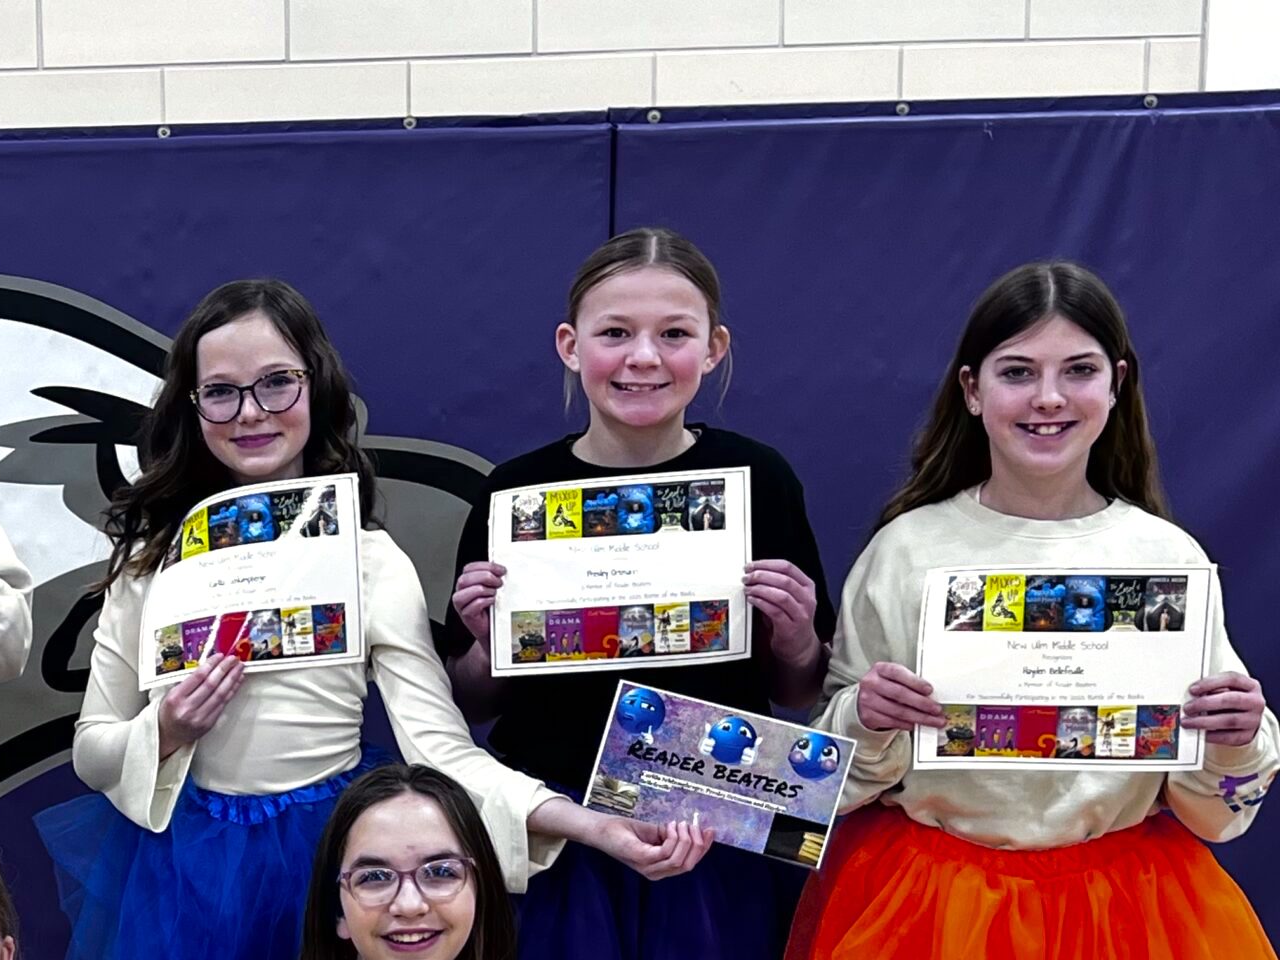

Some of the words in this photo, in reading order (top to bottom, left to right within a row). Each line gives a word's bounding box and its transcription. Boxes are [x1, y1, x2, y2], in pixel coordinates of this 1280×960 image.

[548, 617, 581, 626] DRAMA
[1007, 640, 1027, 650] New
[1031, 641, 1048, 650] Ulm
[1052, 640, 1075, 650] Middle
[1080, 640, 1109, 650] School
[979, 713, 1015, 721] DRAMA
[627, 740, 705, 775] READER
[712, 764, 803, 799] BEATERS
